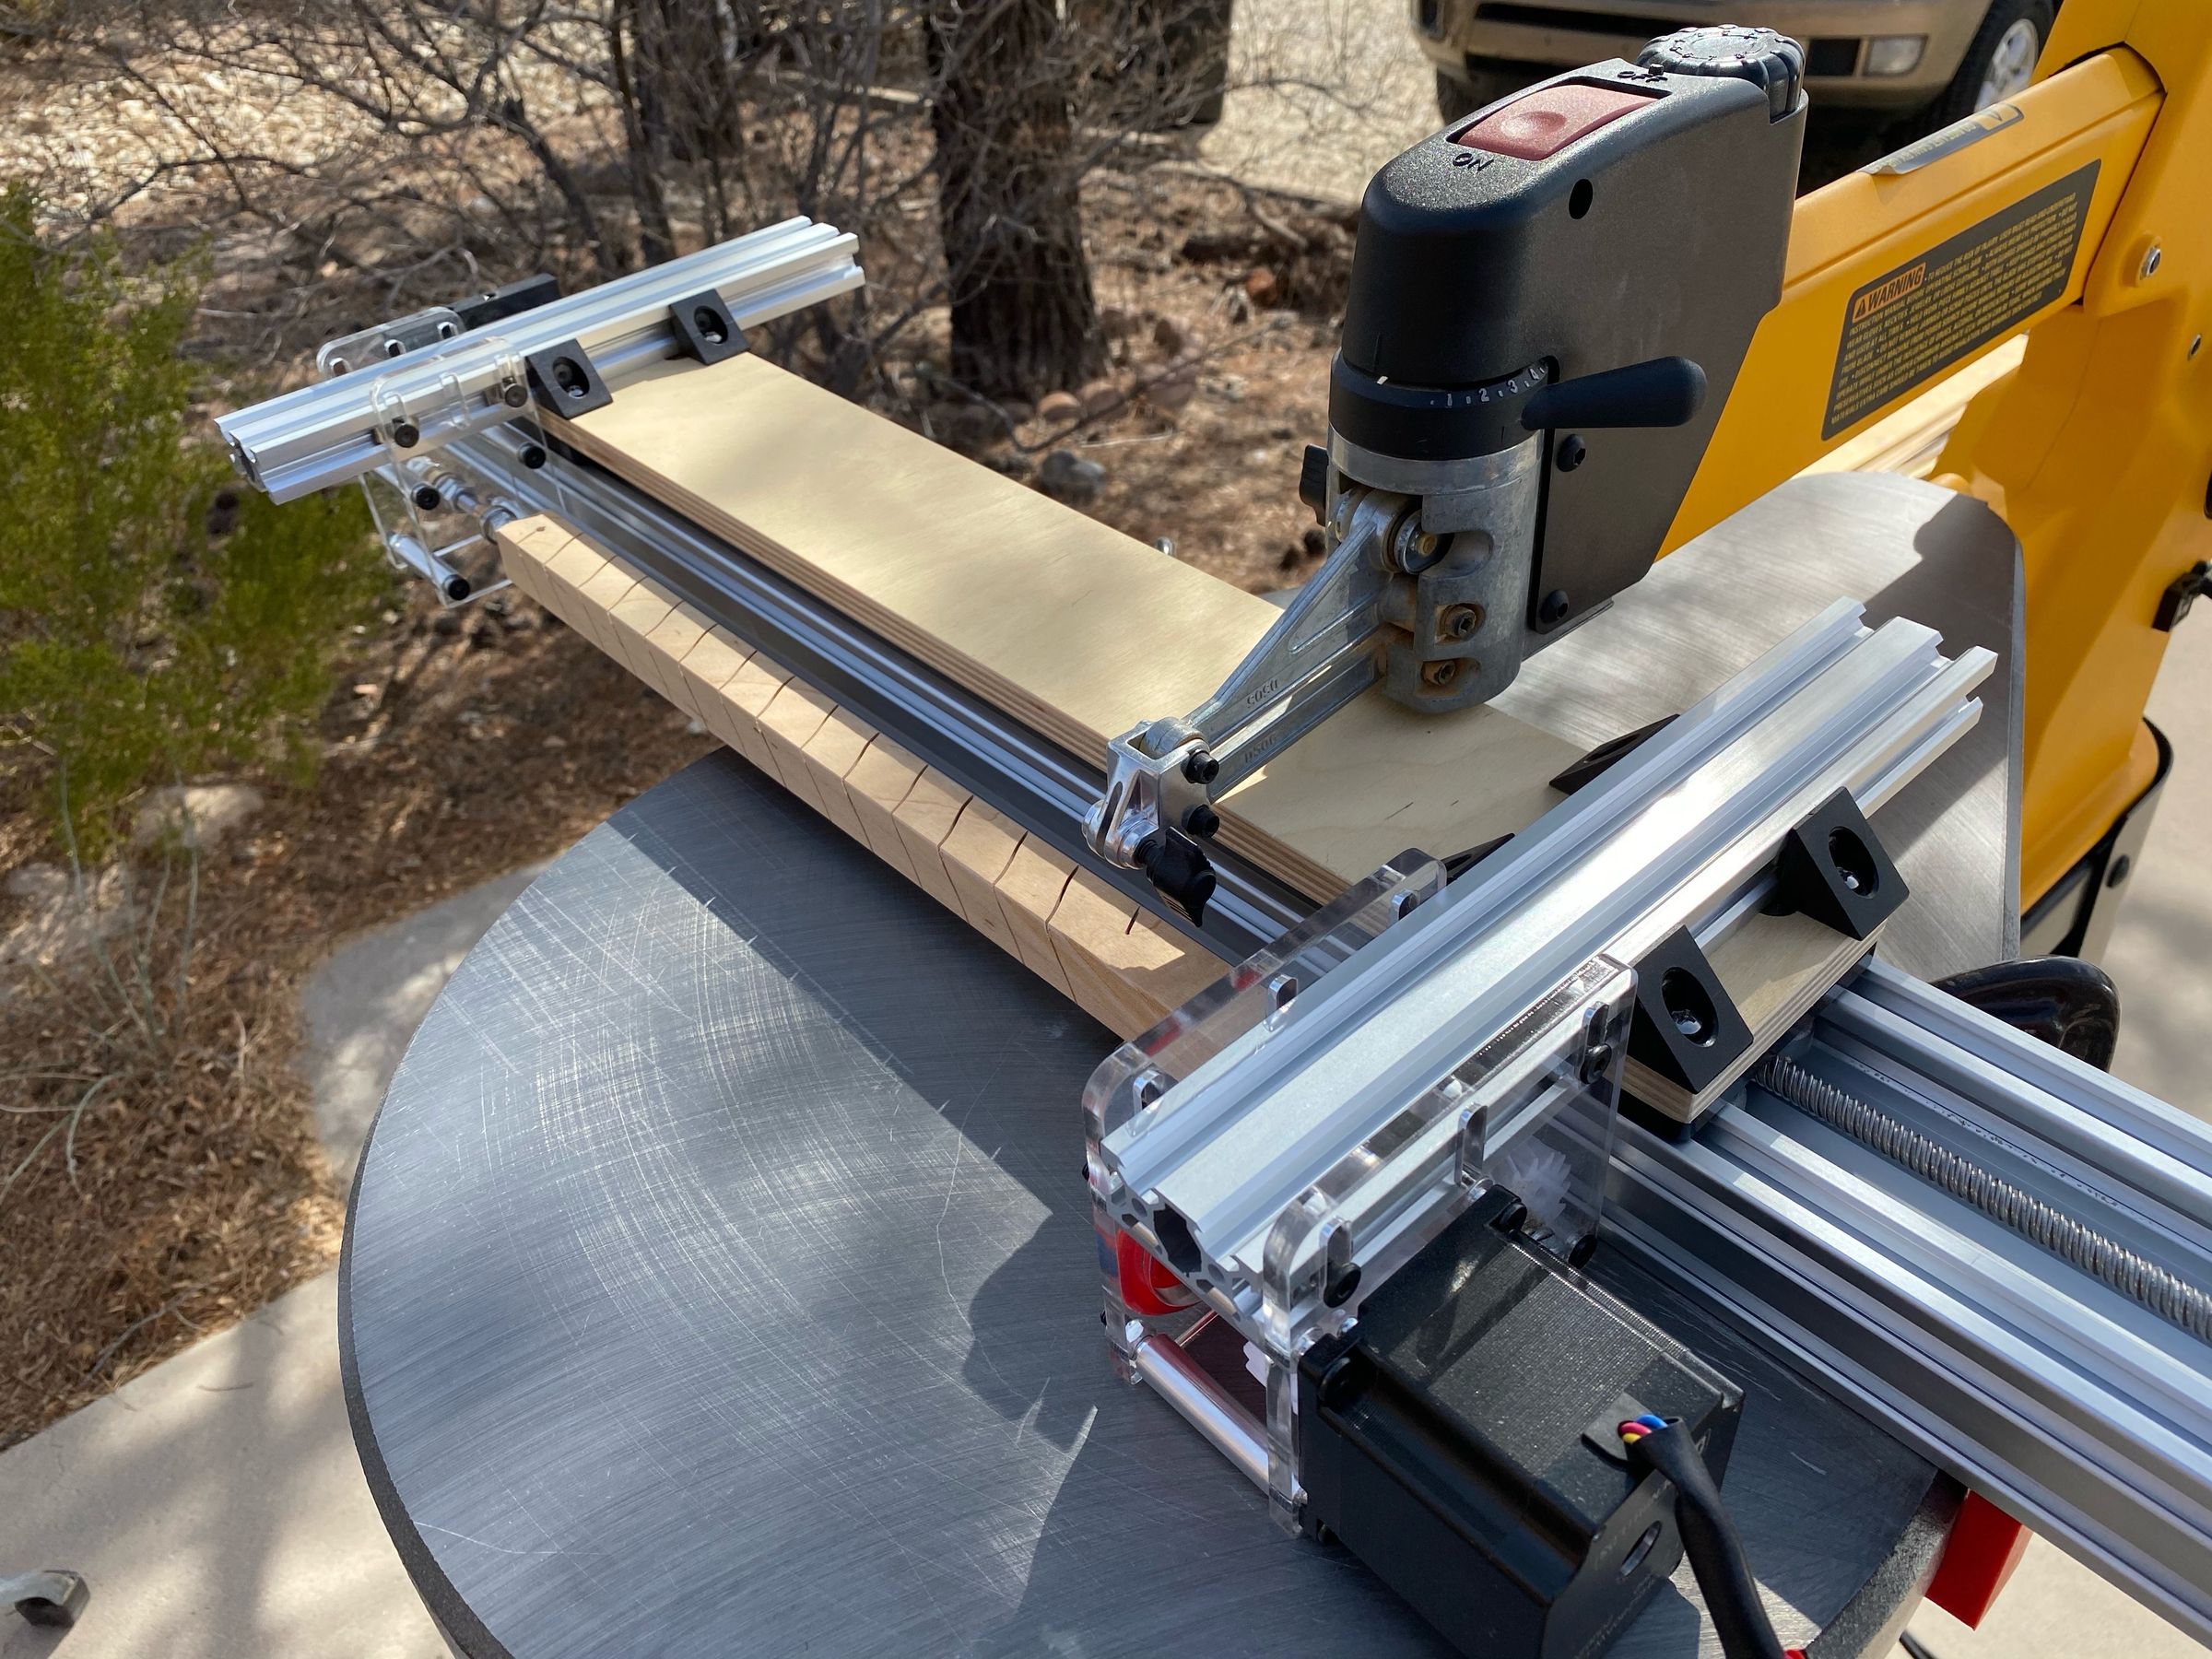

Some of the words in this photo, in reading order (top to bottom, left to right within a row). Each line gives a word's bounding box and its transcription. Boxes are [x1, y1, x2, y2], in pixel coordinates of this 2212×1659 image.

[1618, 70, 1667, 86] OFF
[1453, 152, 1493, 171] ON
[1868, 266, 1924, 312] WARNING
[1478, 388, 1490, 403] 2
[1507, 380, 1519, 394] 3
[1528, 368, 1540, 380] 4
